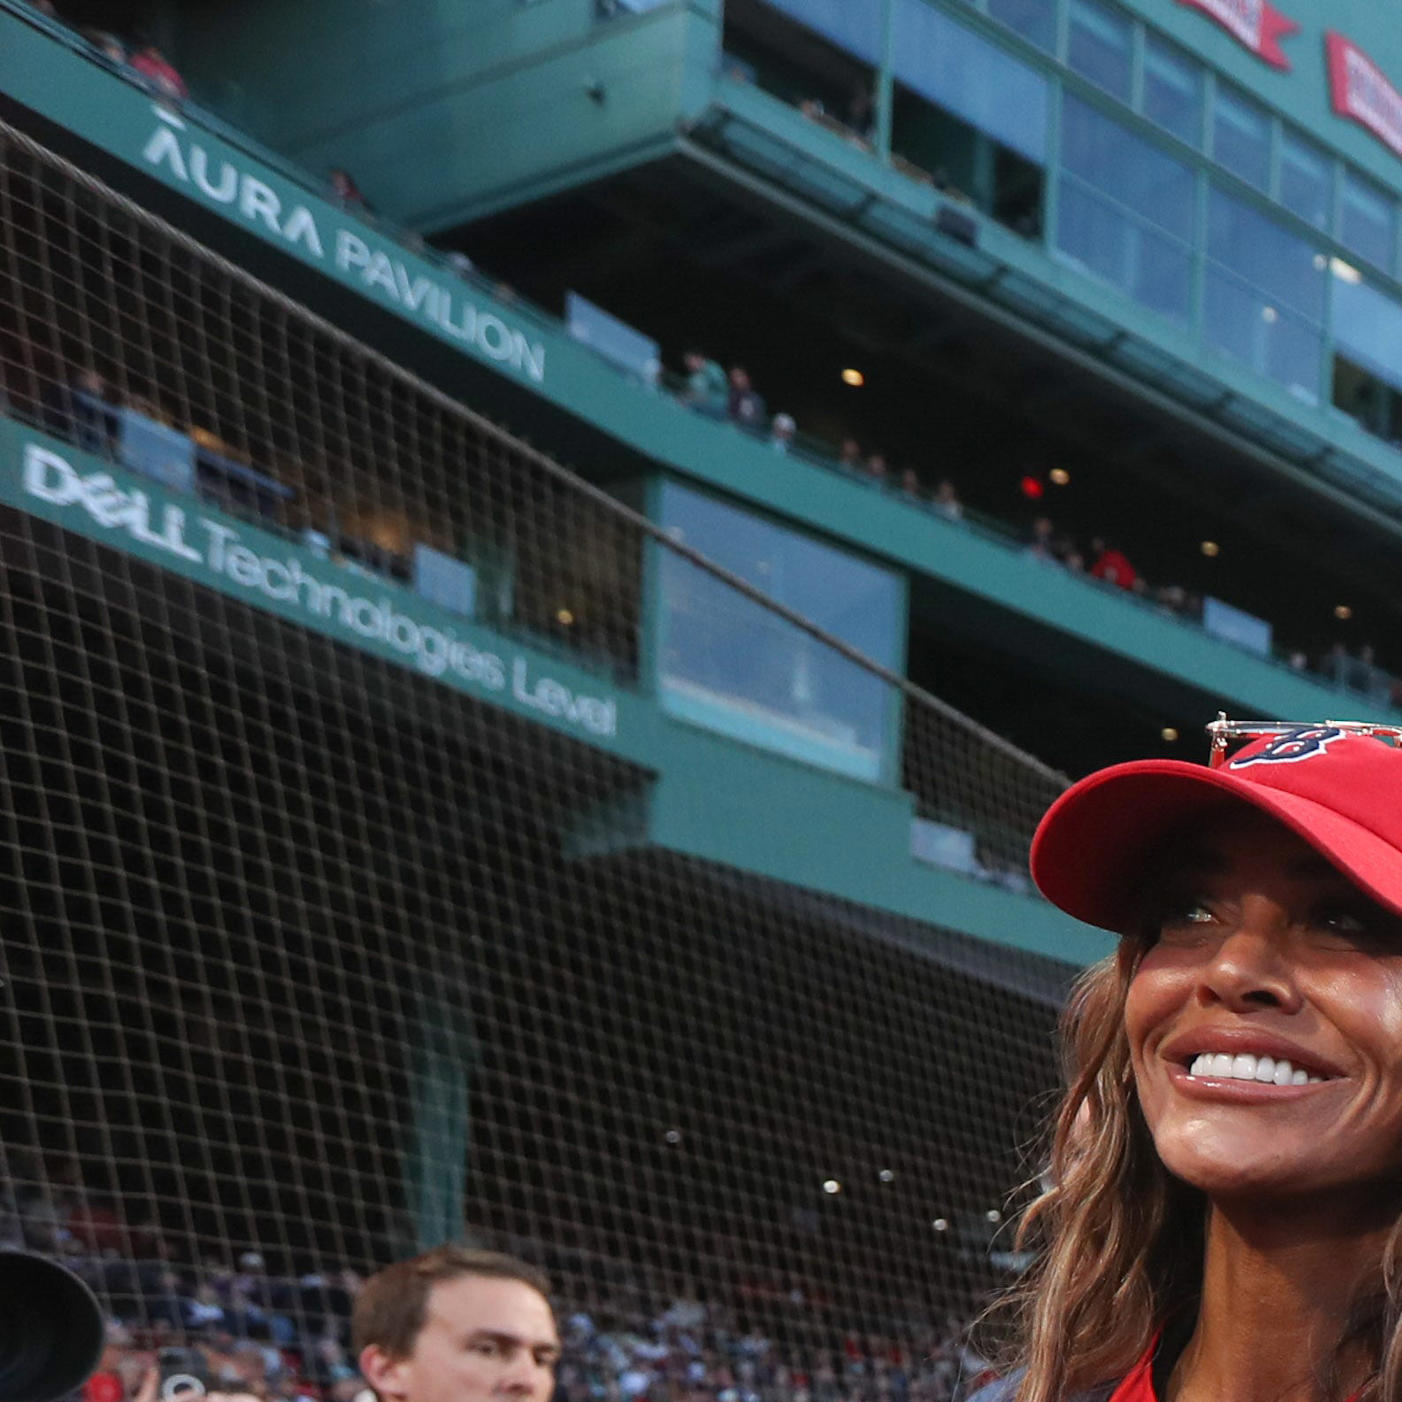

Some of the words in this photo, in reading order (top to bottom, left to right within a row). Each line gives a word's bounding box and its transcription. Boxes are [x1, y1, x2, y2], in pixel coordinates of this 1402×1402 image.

[334, 228, 547, 384] PAVILION
[23, 442, 203, 563] DELL
[202, 518, 507, 690] Technologies
[512, 641, 619, 738] Level
